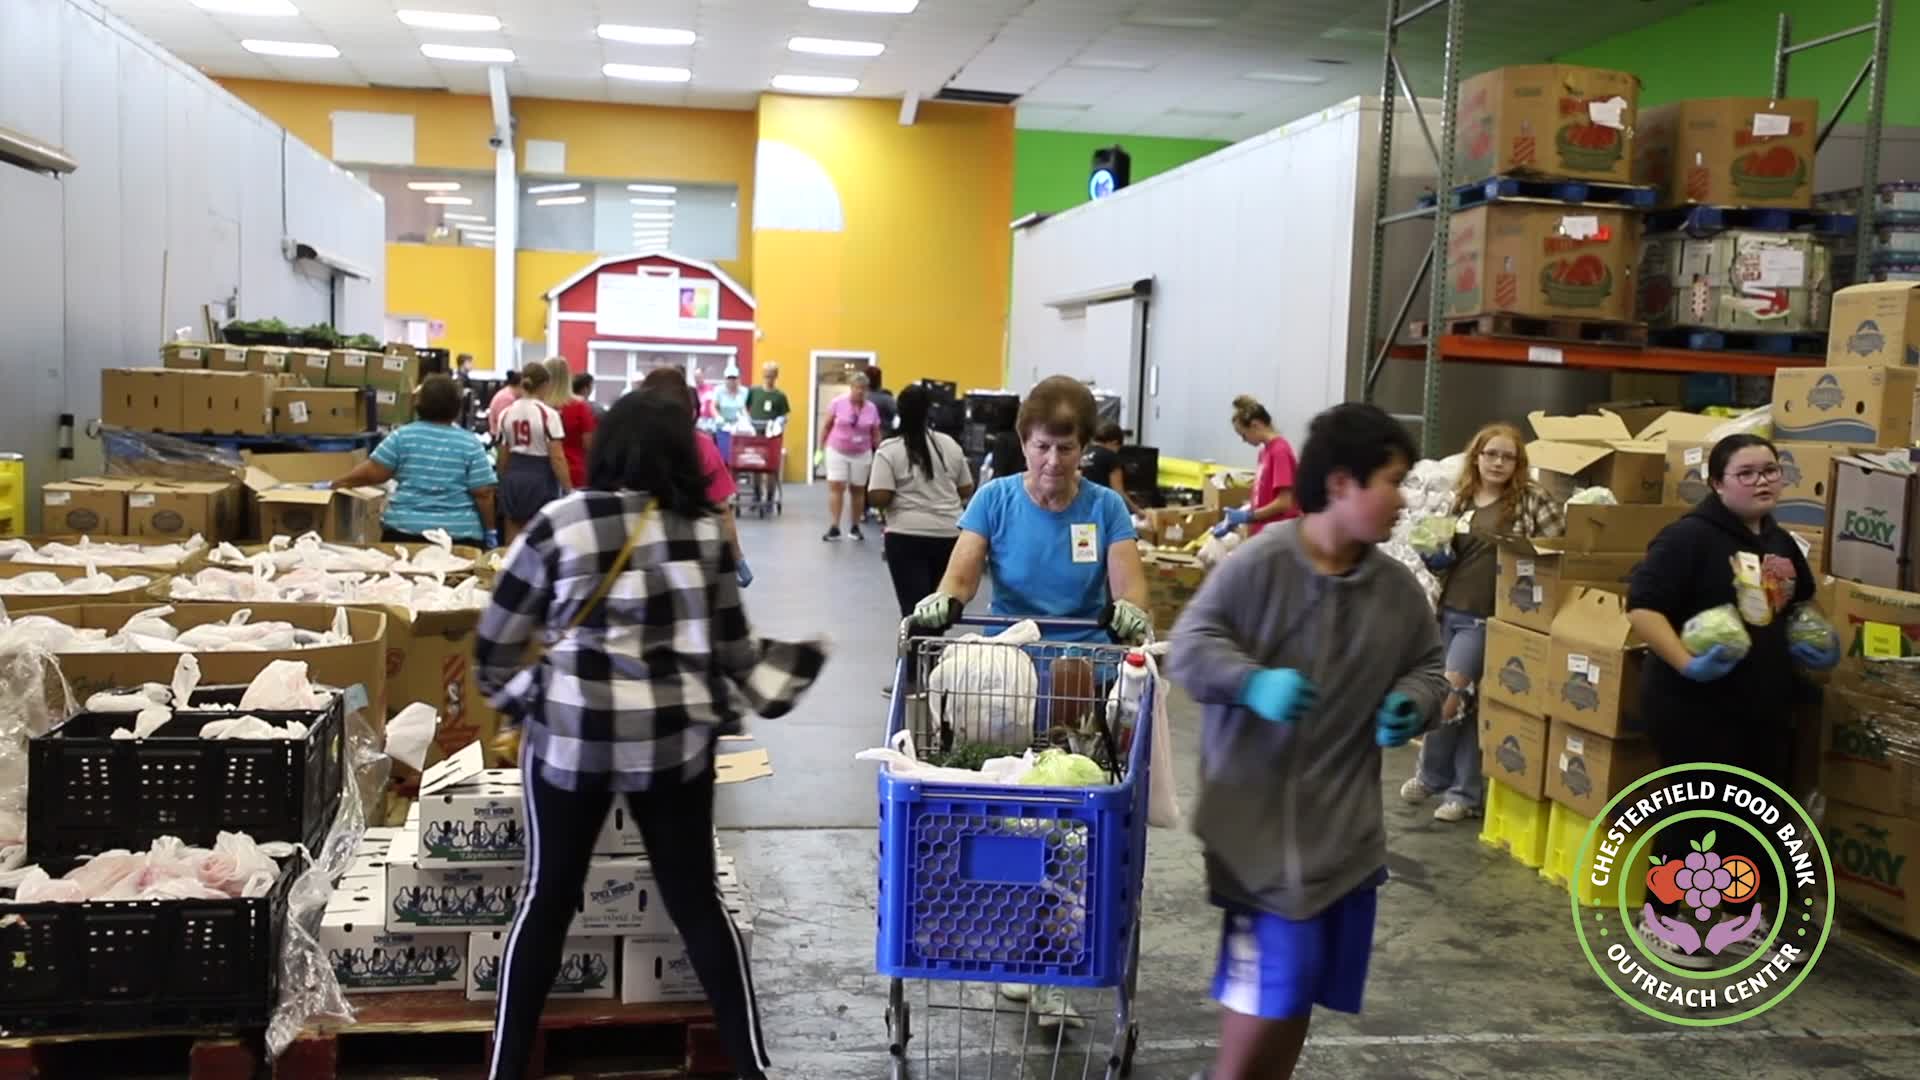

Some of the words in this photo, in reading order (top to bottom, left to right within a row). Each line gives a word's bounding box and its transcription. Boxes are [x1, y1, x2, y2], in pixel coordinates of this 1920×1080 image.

[512, 420, 531, 446] 19
[1844, 509, 1896, 543] FOXY
[1829, 826, 1906, 886] FOXY
